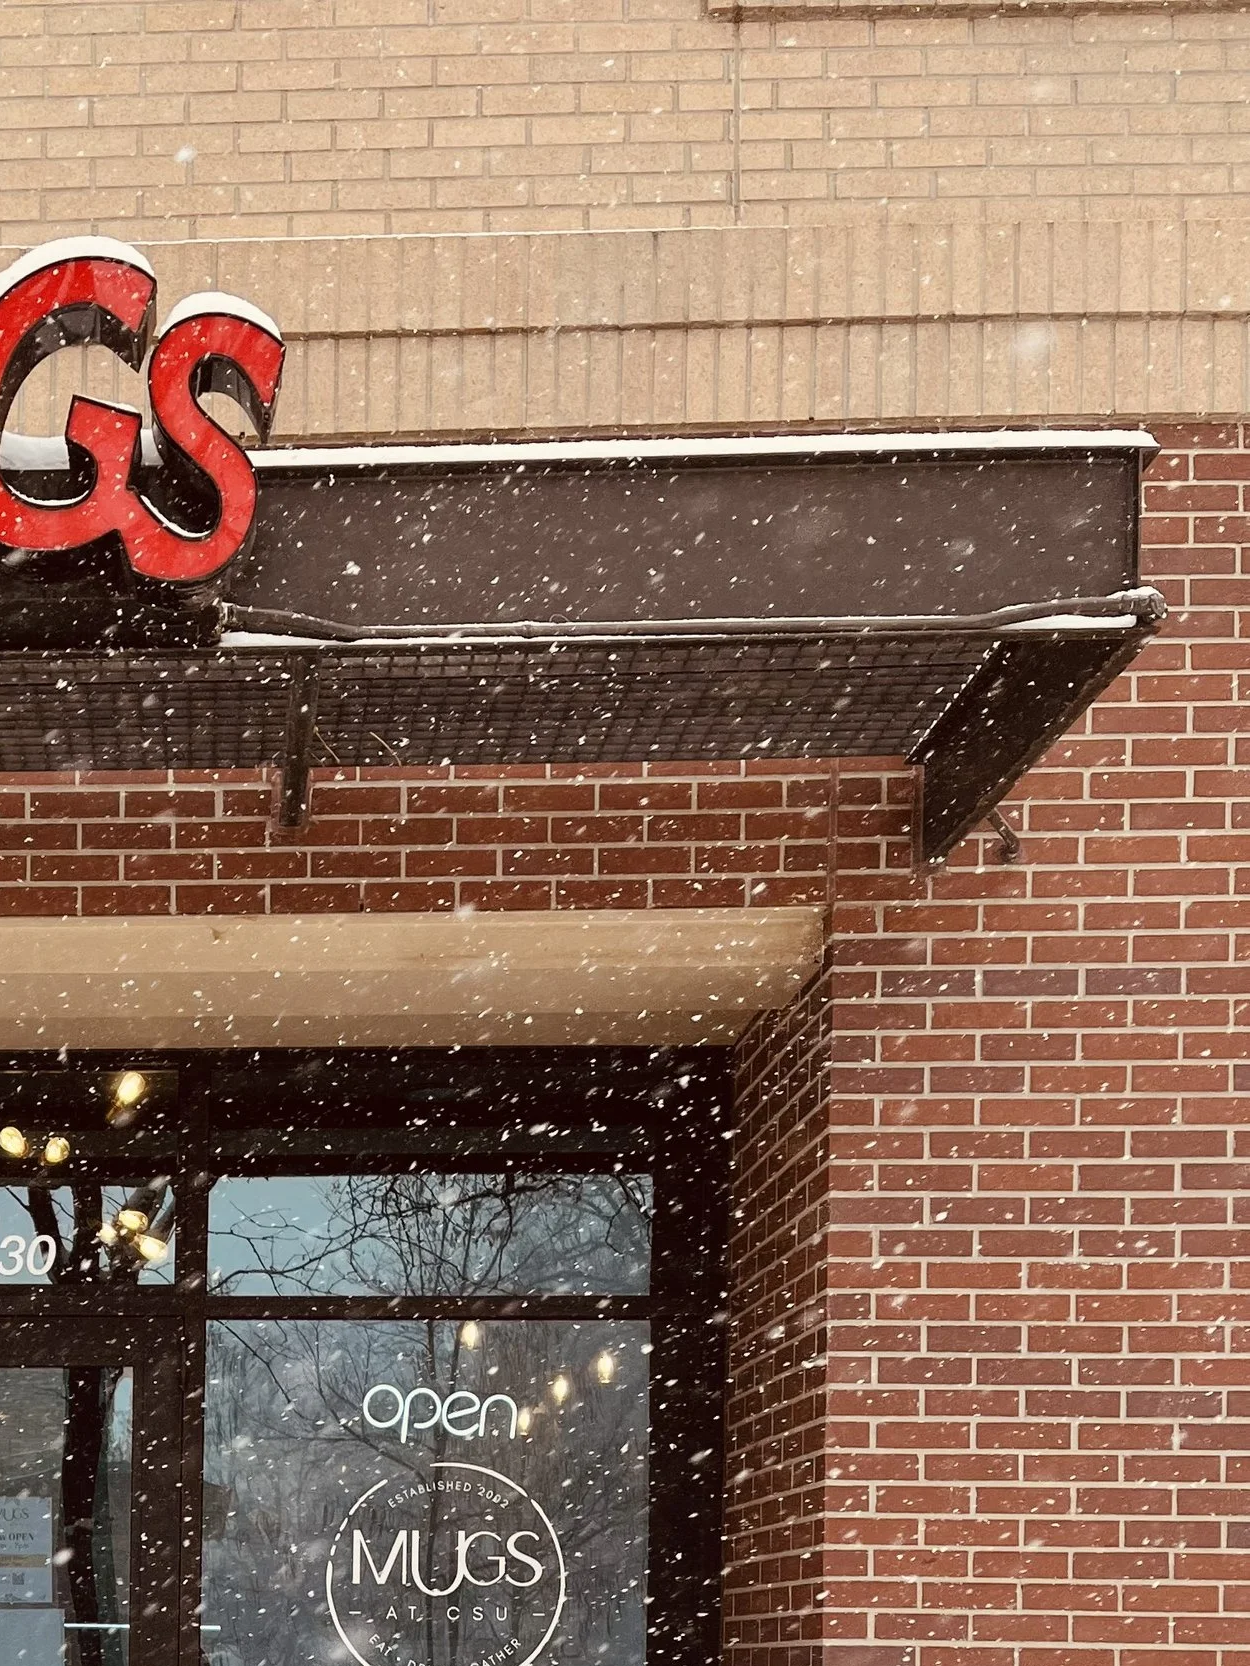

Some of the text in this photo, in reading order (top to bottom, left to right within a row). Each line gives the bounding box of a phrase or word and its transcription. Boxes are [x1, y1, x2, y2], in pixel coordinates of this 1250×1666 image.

[362, 1384, 518, 1443] open
[387, 1480, 510, 1509] ESTABLISHED 2002
[351, 1529, 544, 1596] MUGS
[385, 1605, 509, 1622] AT CSU
[368, 1633, 393, 1657] EAT
